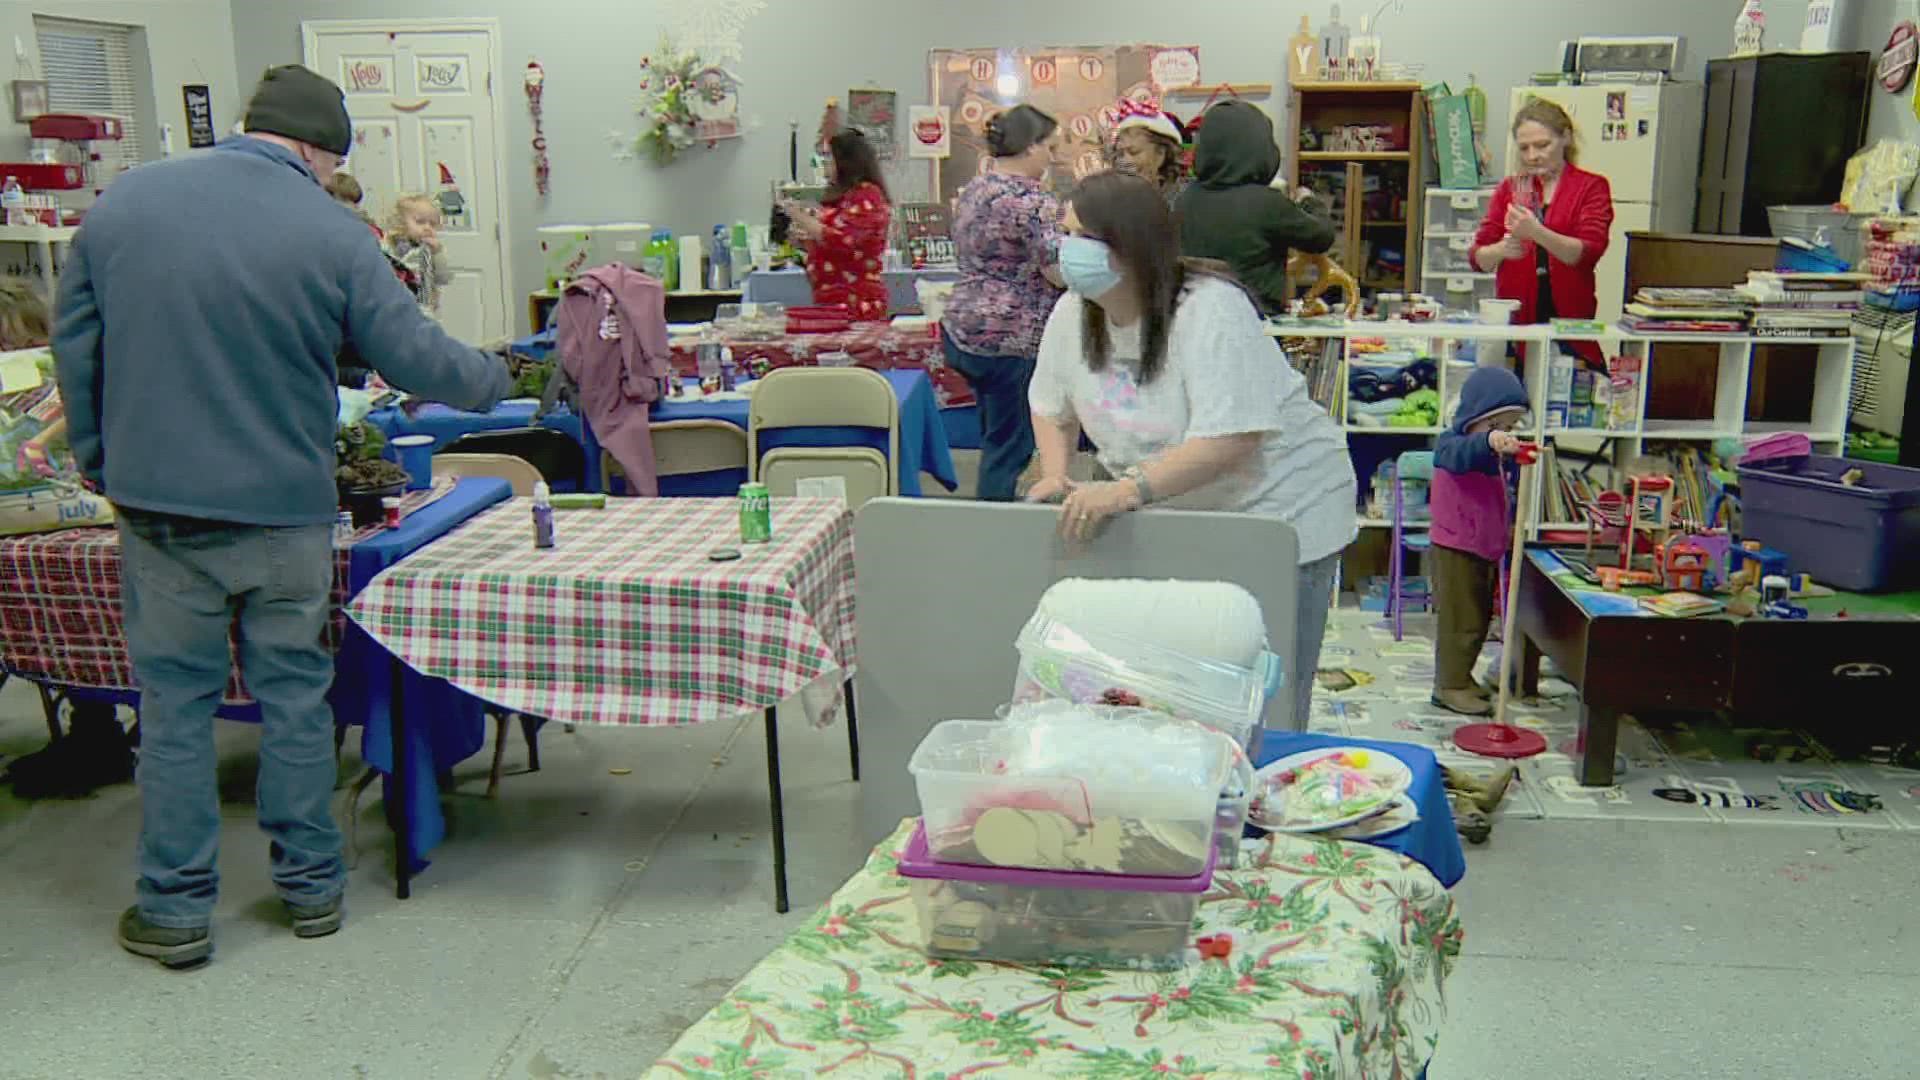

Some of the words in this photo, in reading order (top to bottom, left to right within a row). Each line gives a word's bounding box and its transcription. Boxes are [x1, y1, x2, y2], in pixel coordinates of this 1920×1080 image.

[350, 61, 382, 91] Holly
[57, 499, 98, 523] july
[737, 496, 768, 512] rite
